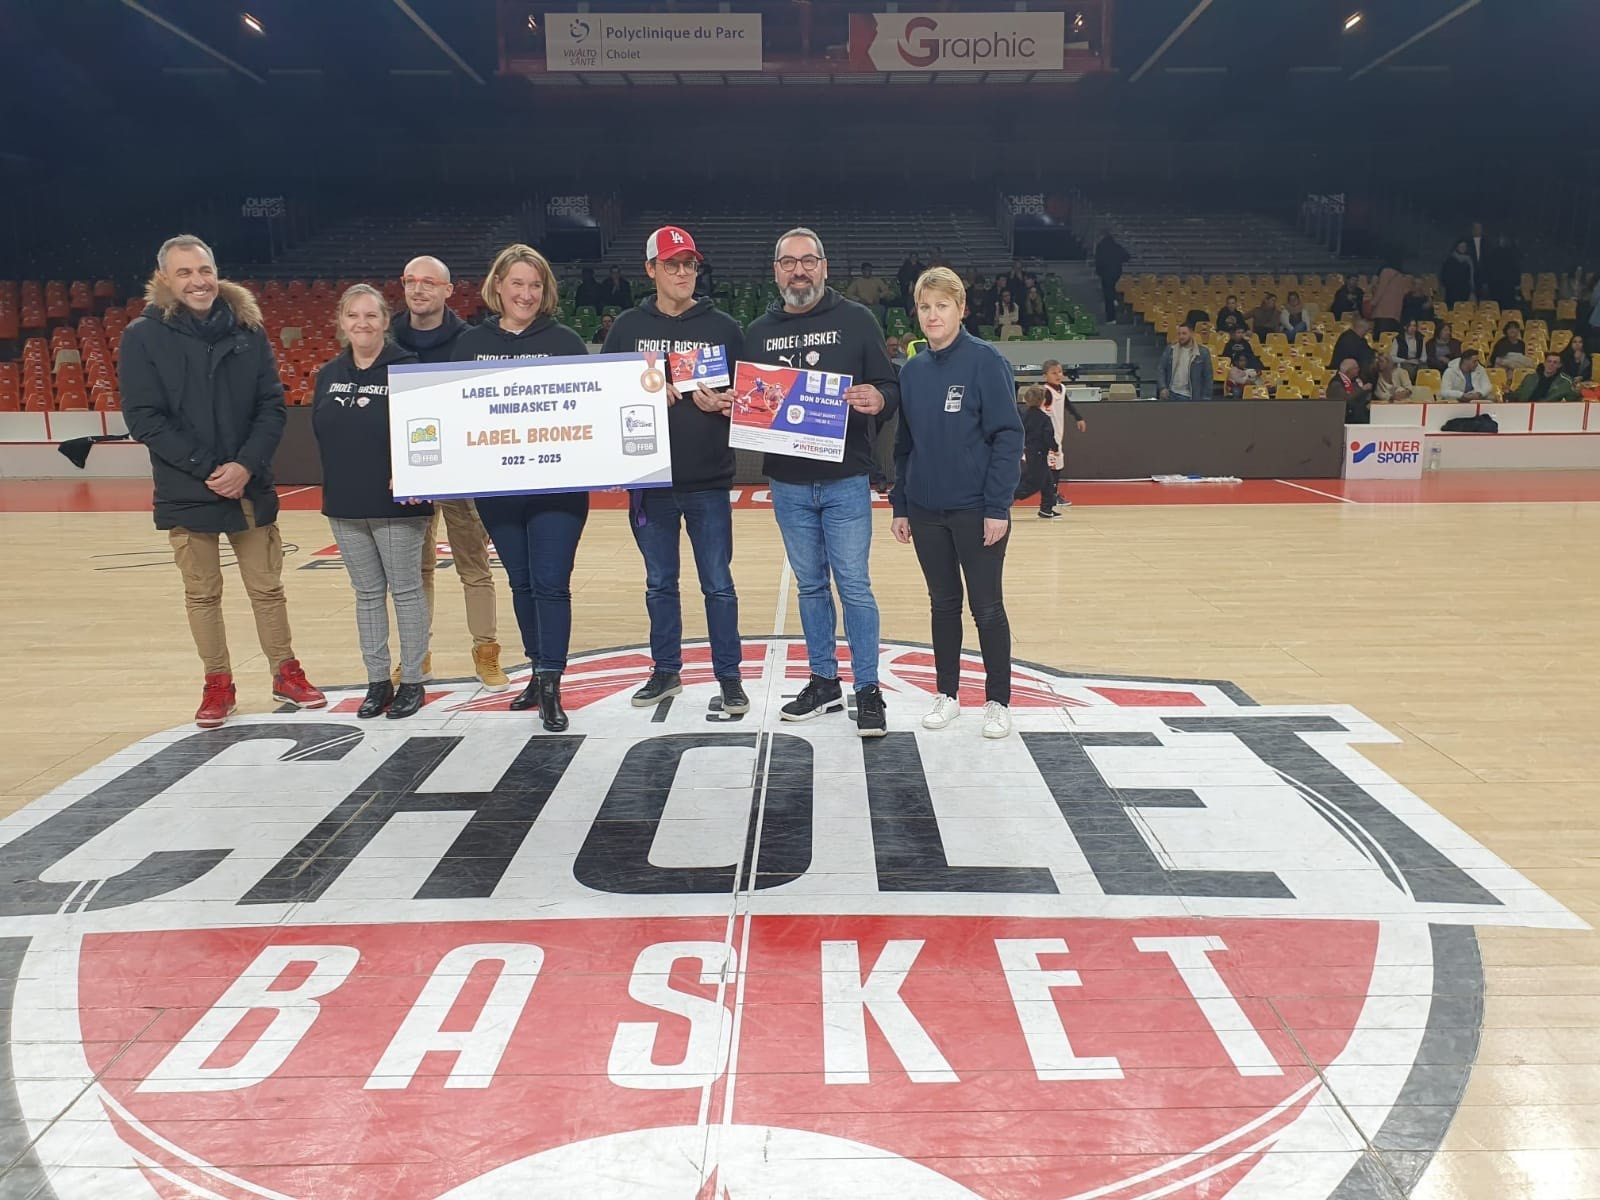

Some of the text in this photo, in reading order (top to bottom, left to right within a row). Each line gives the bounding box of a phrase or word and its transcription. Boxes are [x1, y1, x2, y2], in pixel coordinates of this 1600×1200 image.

[606, 26, 745, 41] Polyclinique du Parc
[897, 16, 1036, 67] Graphic
[606, 49, 641, 60] Cholet
[551, 194, 590, 206] ouest
[547, 203, 590, 217] france
[669, 230, 685, 244] LA
[638, 339, 671, 353] CHOLET
[766, 331, 838, 352] CHOLET BASKET
[462, 381, 602, 399] LABEL DÉPARTEMENTAL
[489, 399, 577, 415] MINIBASKET 49
[466, 424, 593, 447] LABEL BRONZE
[799, 444, 842, 455] INTERSPORT
[1378, 441, 1420, 452] INTER
[501, 455, 525, 465] 2022
[538, 453, 562, 464] 2025
[1377, 452, 1420, 464] SPORT
[0, 715, 1506, 917] CHOLET
[135, 935, 1285, 1093] BASKET
